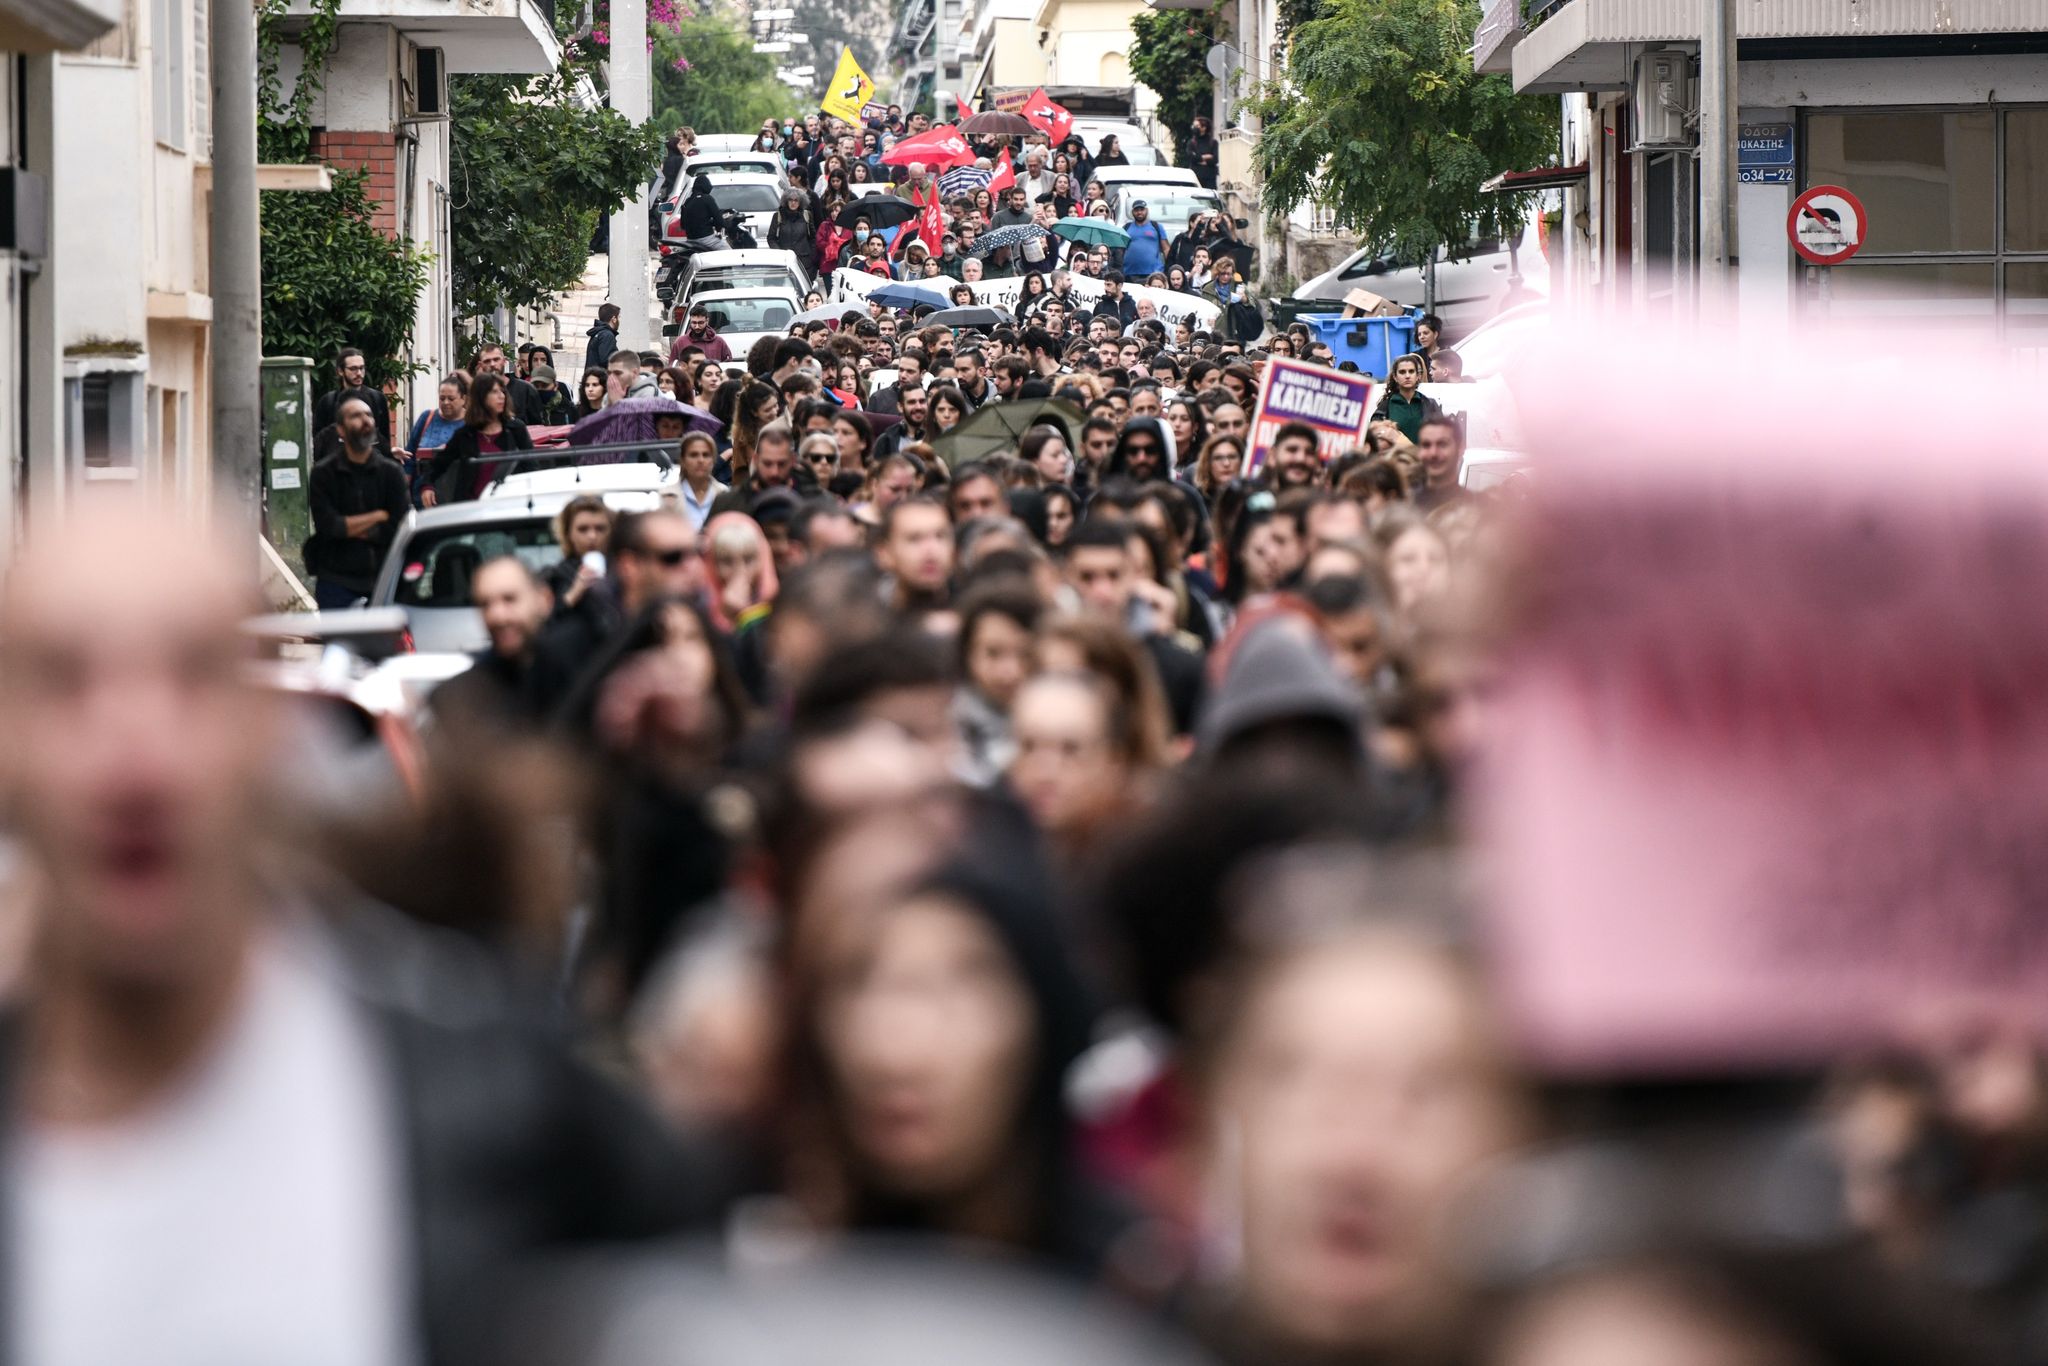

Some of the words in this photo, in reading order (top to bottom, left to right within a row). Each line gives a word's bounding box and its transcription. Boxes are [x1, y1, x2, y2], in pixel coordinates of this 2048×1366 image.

[1744, 128, 1777, 136] ΟΔΟΣ
[1279, 369, 1322, 392] ΕΝΑΝΤΙΑ
[1323, 380, 1349, 396] ΣΤΗΝ
[1267, 382, 1363, 429] ΚΑΤΑΠΙΕΣΗ
